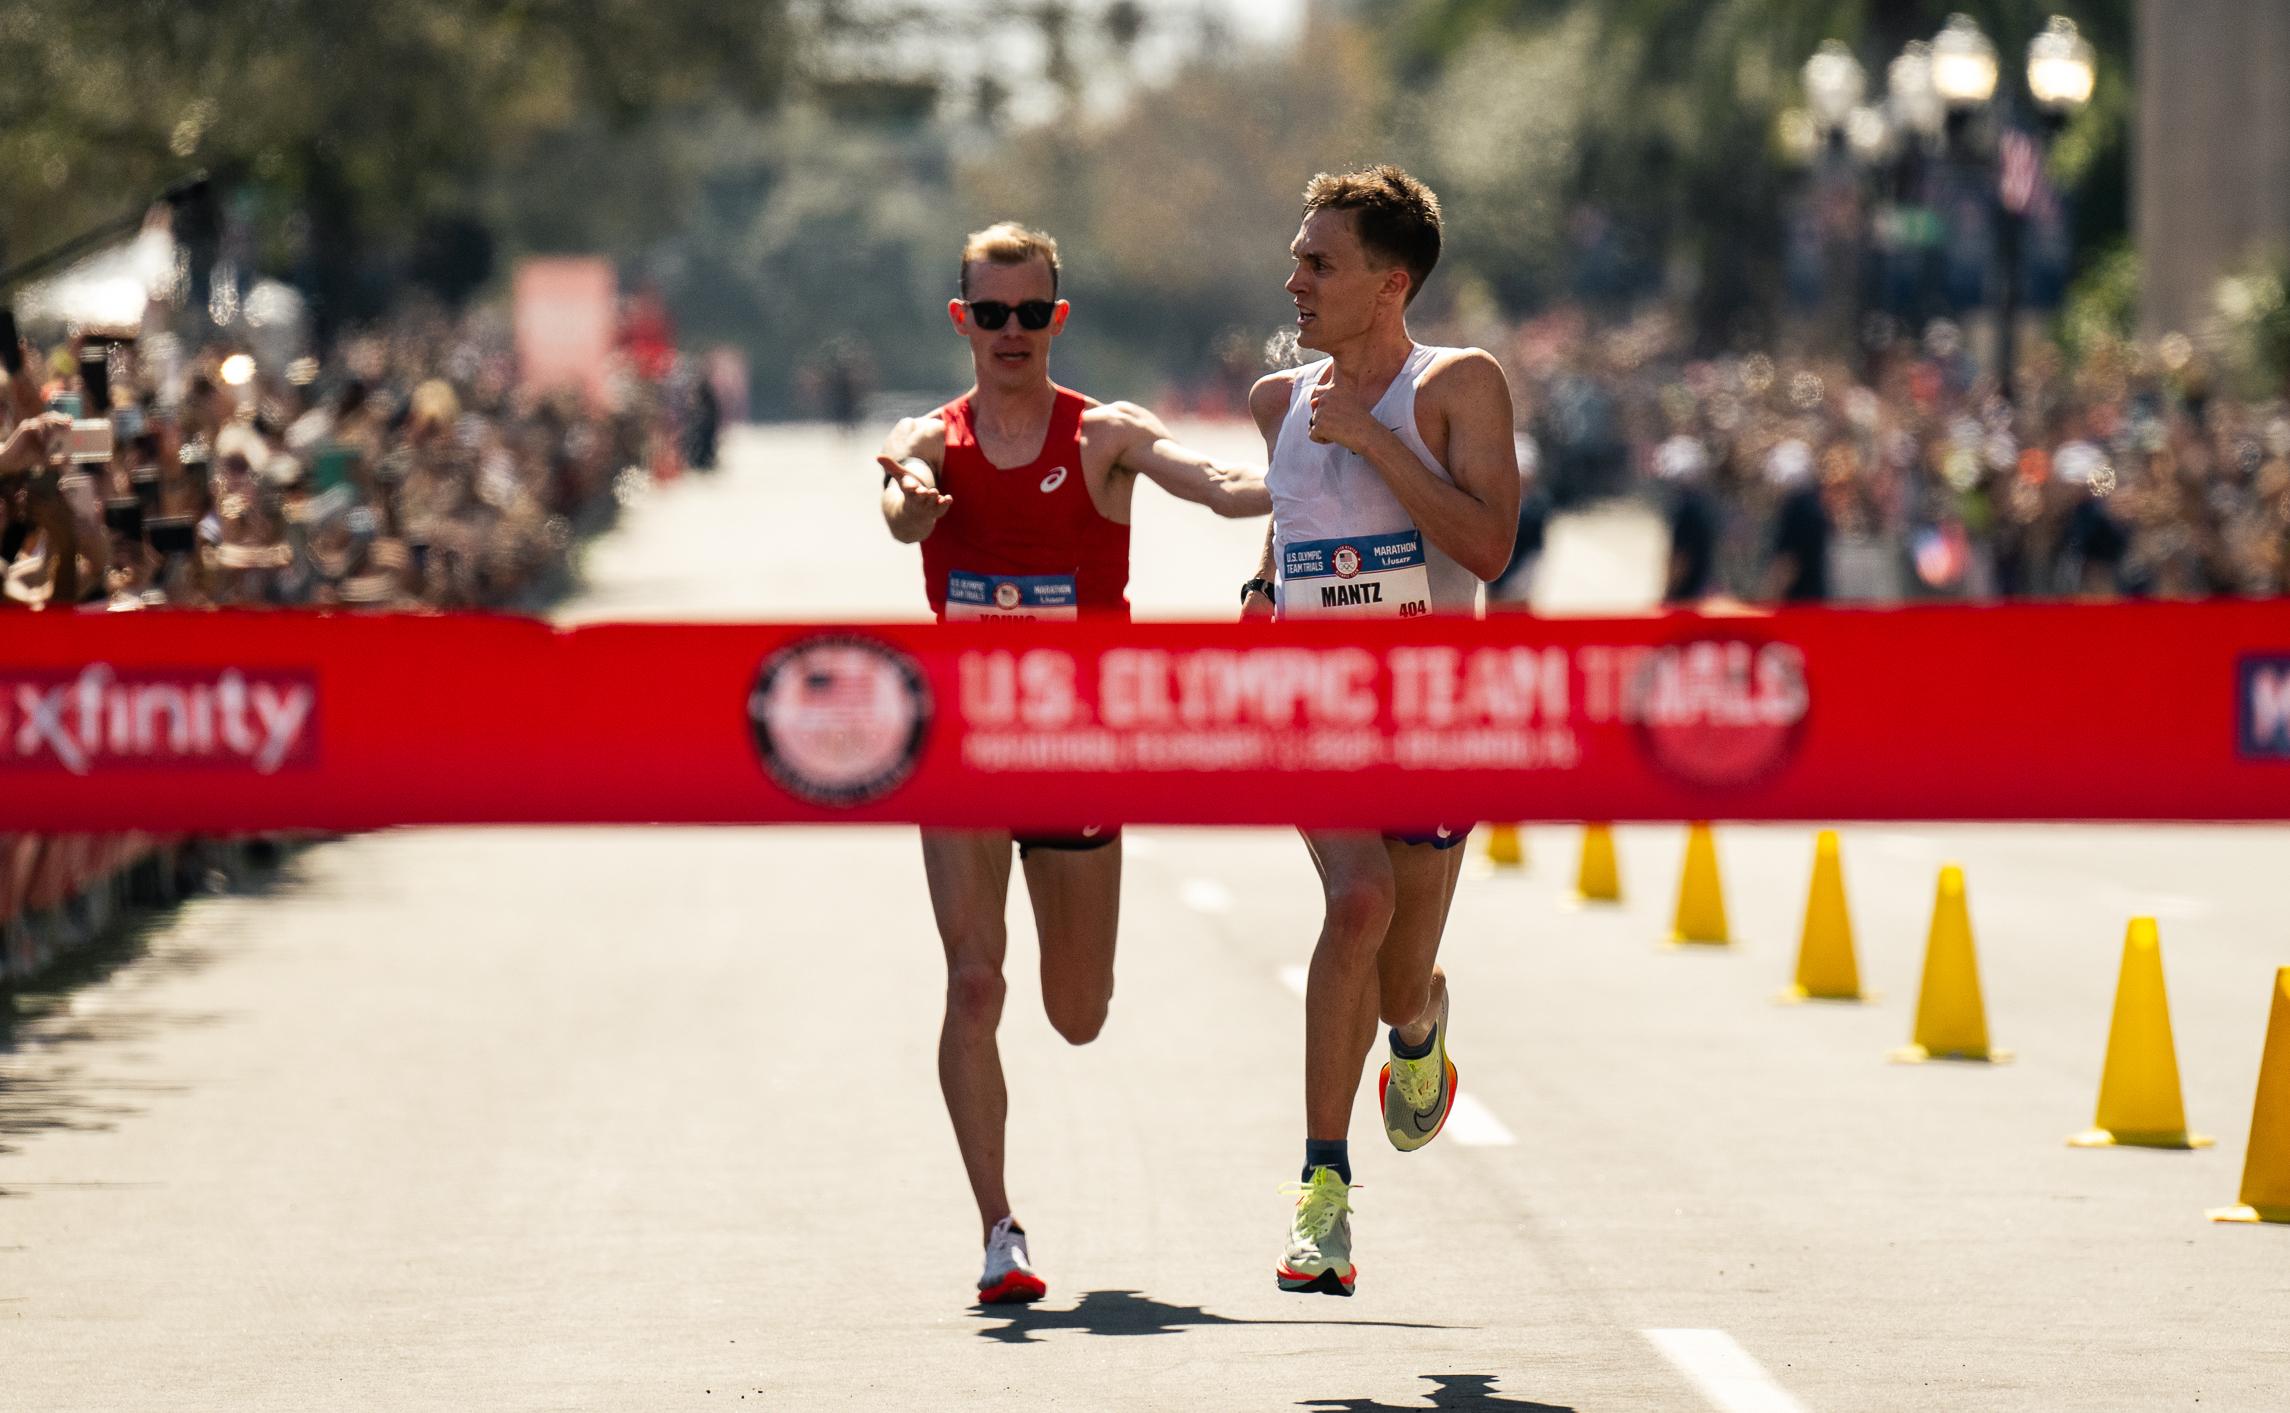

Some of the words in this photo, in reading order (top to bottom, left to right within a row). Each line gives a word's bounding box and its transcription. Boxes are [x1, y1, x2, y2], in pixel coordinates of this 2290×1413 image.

[1286, 552, 1298, 563] U.S.
[1298, 550, 1323, 562] OLYMPIC
[1373, 541, 1417, 556] MARATHON
[1286, 563, 1302, 574] TEAM
[1302, 562, 1324, 573] TRIALS
[1321, 582, 1383, 608] MANTZ
[1399, 600, 1427, 618] 404
[958, 648, 1093, 729] U.S.
[1100, 646, 1379, 729] OLYMPIC
[1386, 645, 1570, 728] TEAM
[14, 661, 316, 776] xfinity
